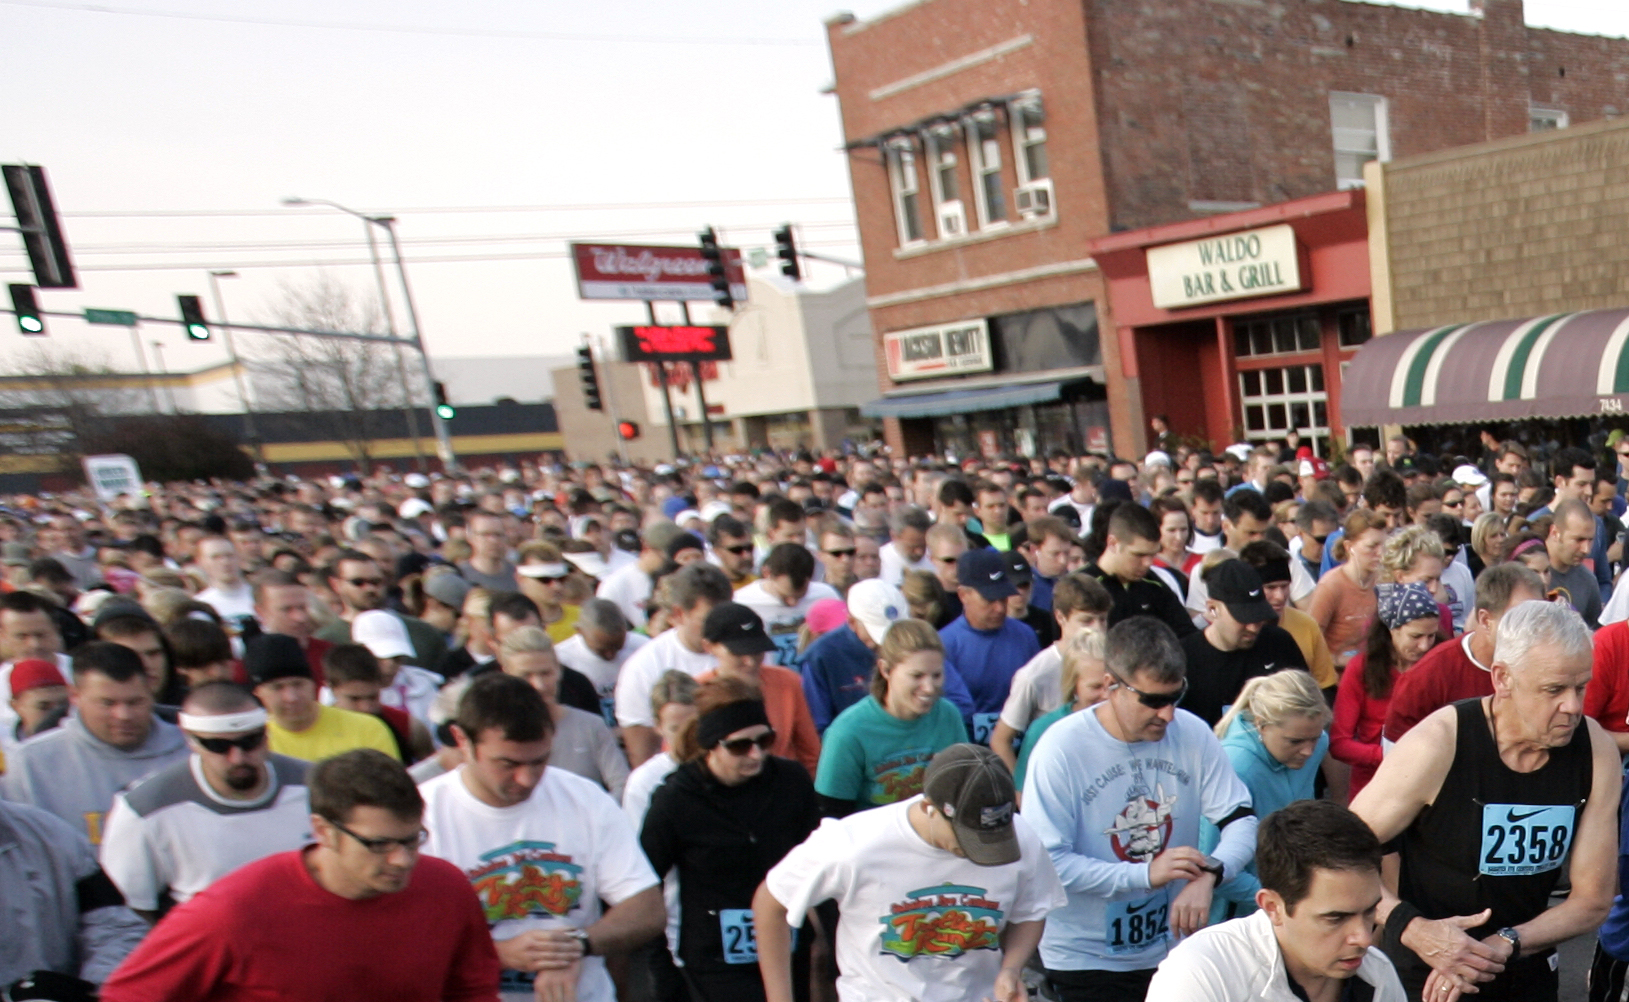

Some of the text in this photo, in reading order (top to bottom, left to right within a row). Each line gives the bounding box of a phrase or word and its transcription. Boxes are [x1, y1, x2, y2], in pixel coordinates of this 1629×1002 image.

[589, 246, 711, 281] Walgreen
[1198, 233, 1260, 266] WALDO
[1182, 260, 1284, 297] BAR & GRILL
[1599, 398, 1621, 412] 7434
[1082, 785, 1099, 806] JUST
[1095, 763, 1126, 789] CAUSE
[1485, 825, 1567, 864] 2358
[1111, 903, 1169, 946] 1852
